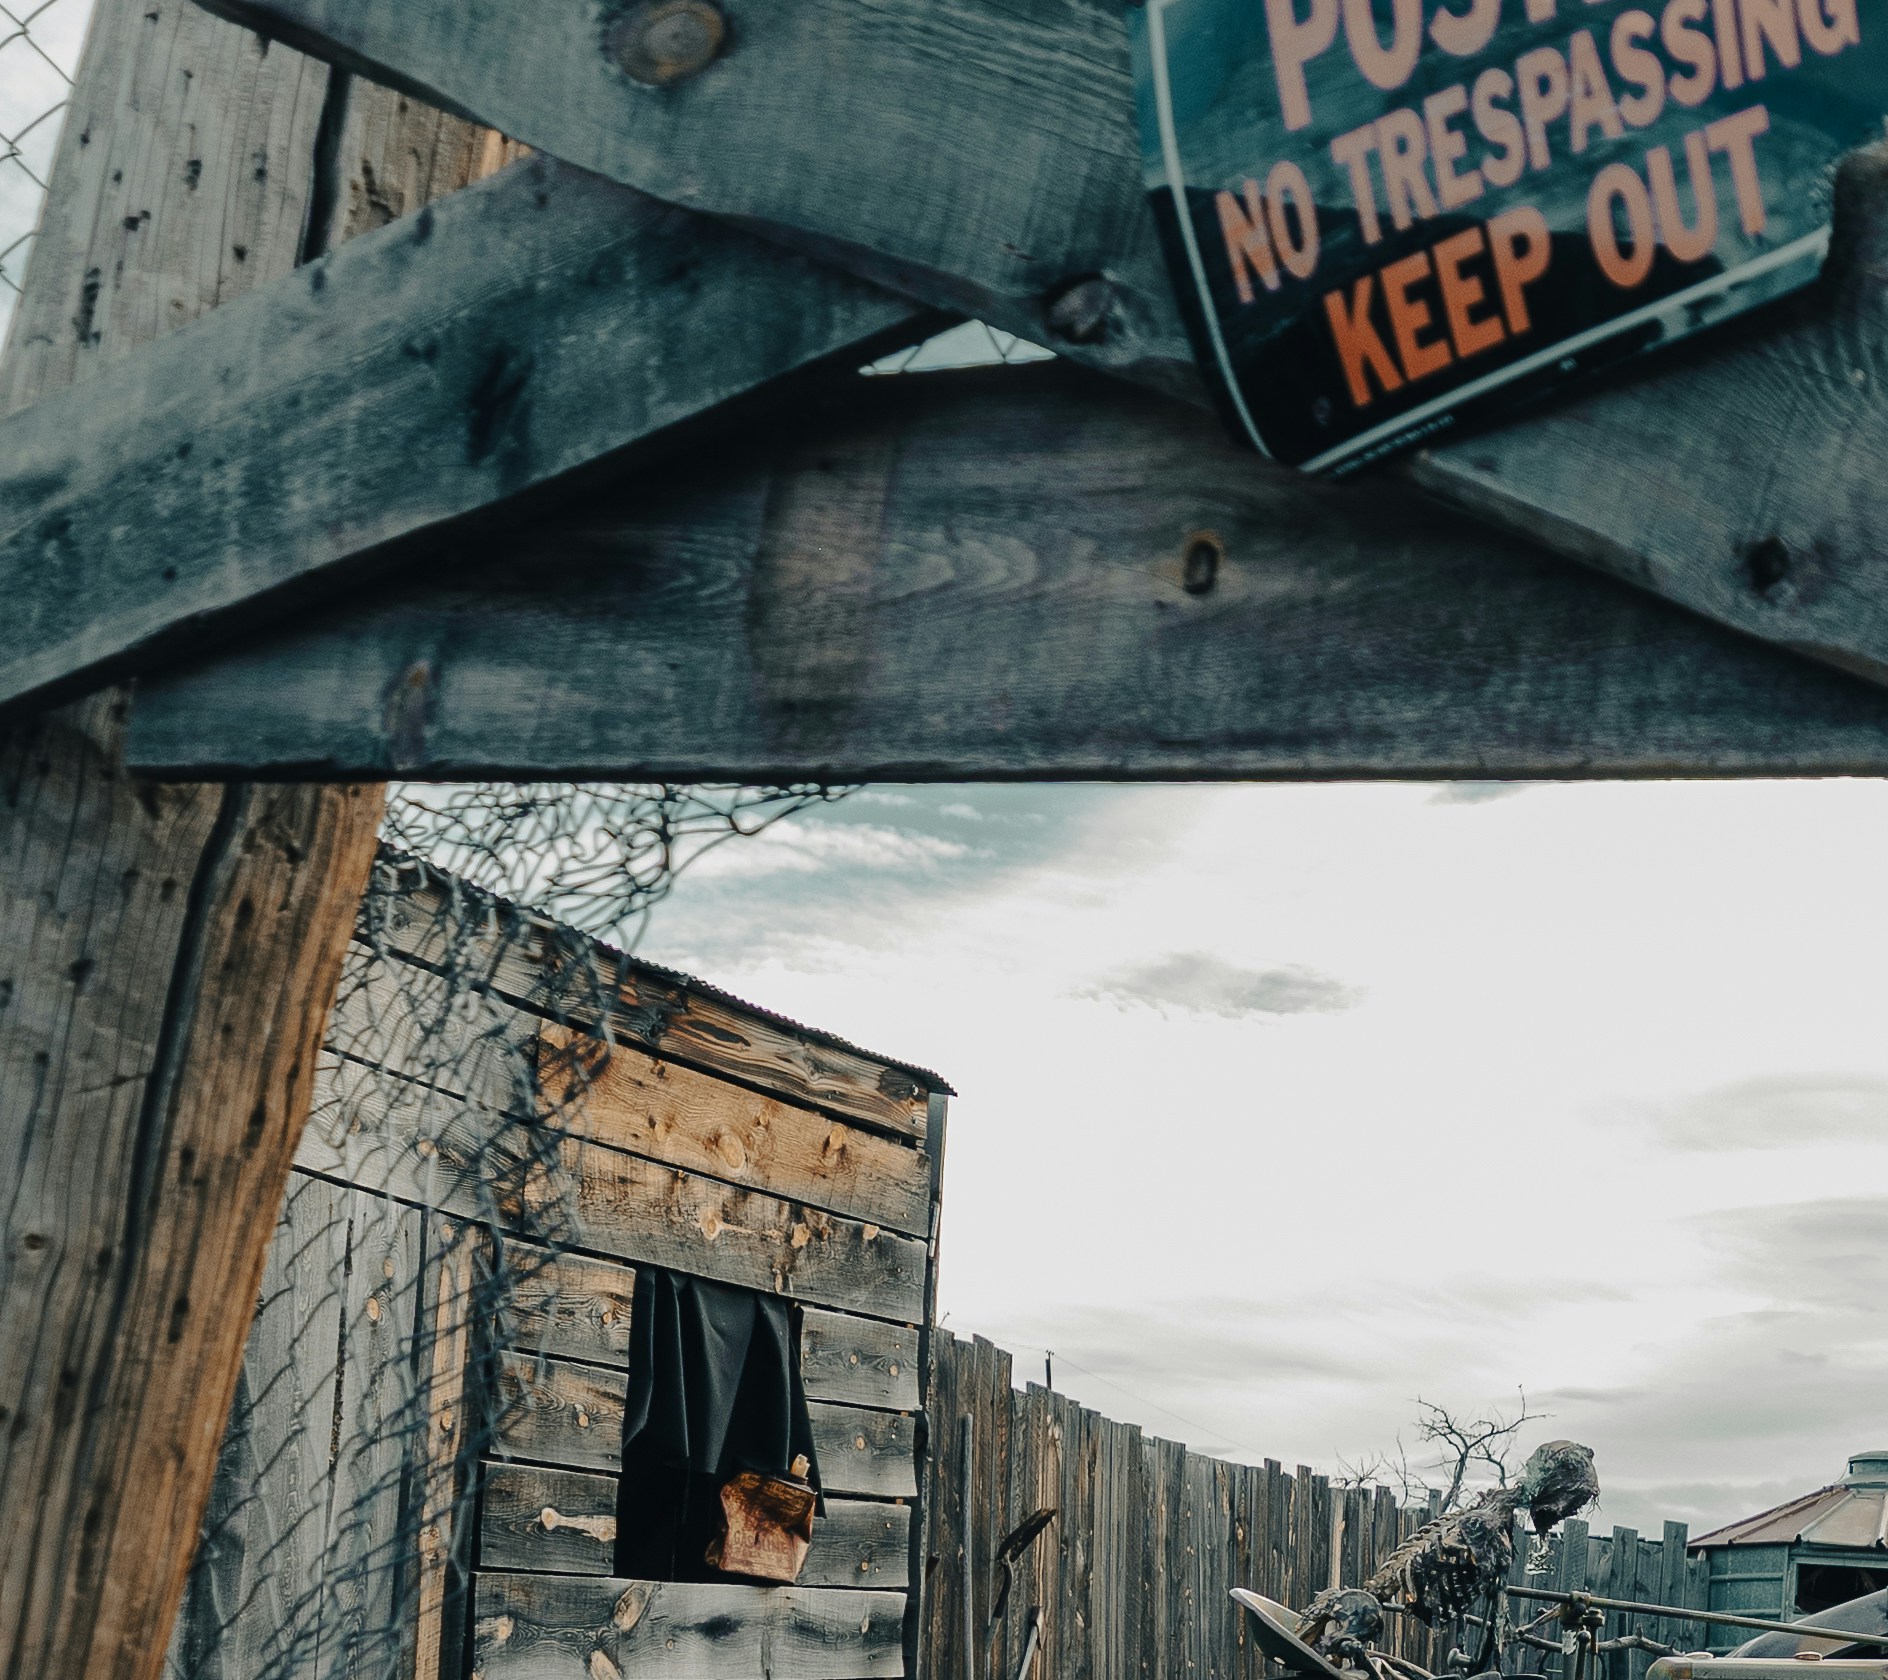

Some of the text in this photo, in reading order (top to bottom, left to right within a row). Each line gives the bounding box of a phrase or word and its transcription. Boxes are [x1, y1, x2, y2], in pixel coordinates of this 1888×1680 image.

[1215, 159, 1322, 306] NO
[1325, 104, 1771, 406] KEEP OUT
[734, 1529, 788, 1554] GASLINE
